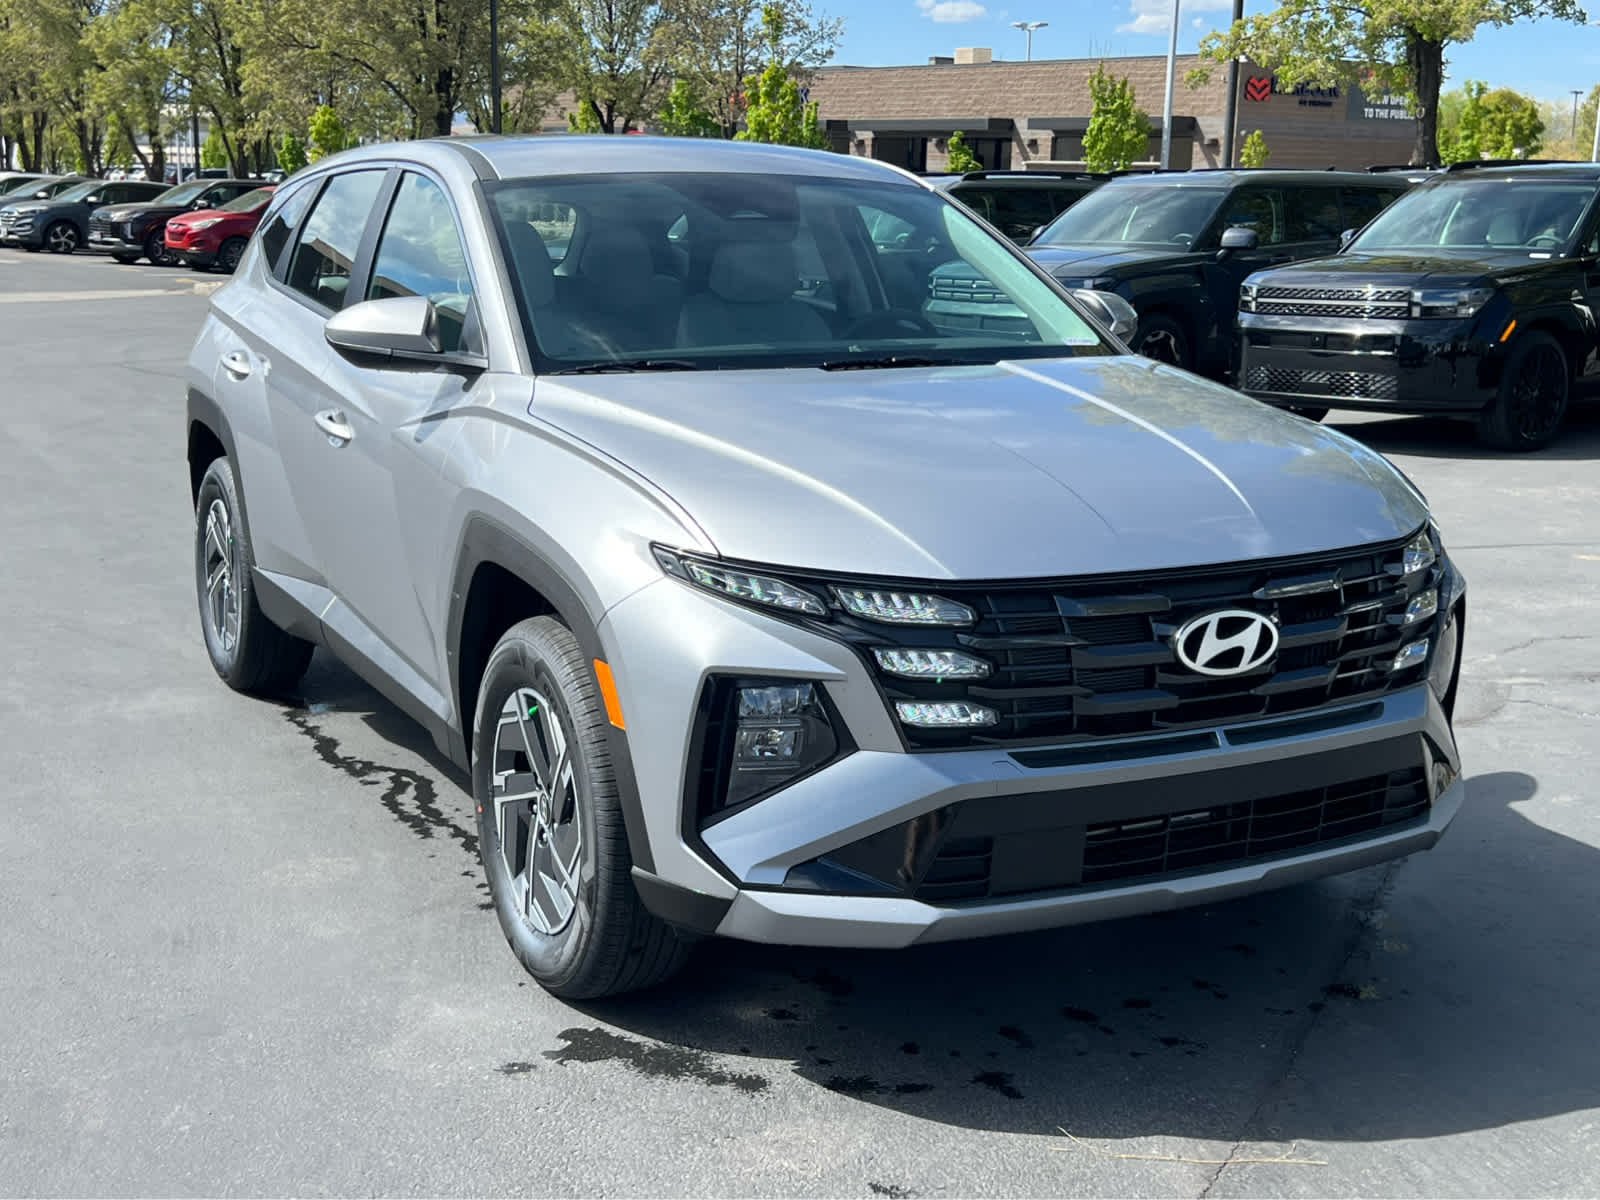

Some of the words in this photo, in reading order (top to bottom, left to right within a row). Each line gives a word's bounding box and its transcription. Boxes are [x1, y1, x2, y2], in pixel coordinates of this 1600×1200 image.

[1364, 108, 1374, 118] TO
[1375, 108, 1389, 119] THE
[1390, 109, 1415, 120] PUBL
